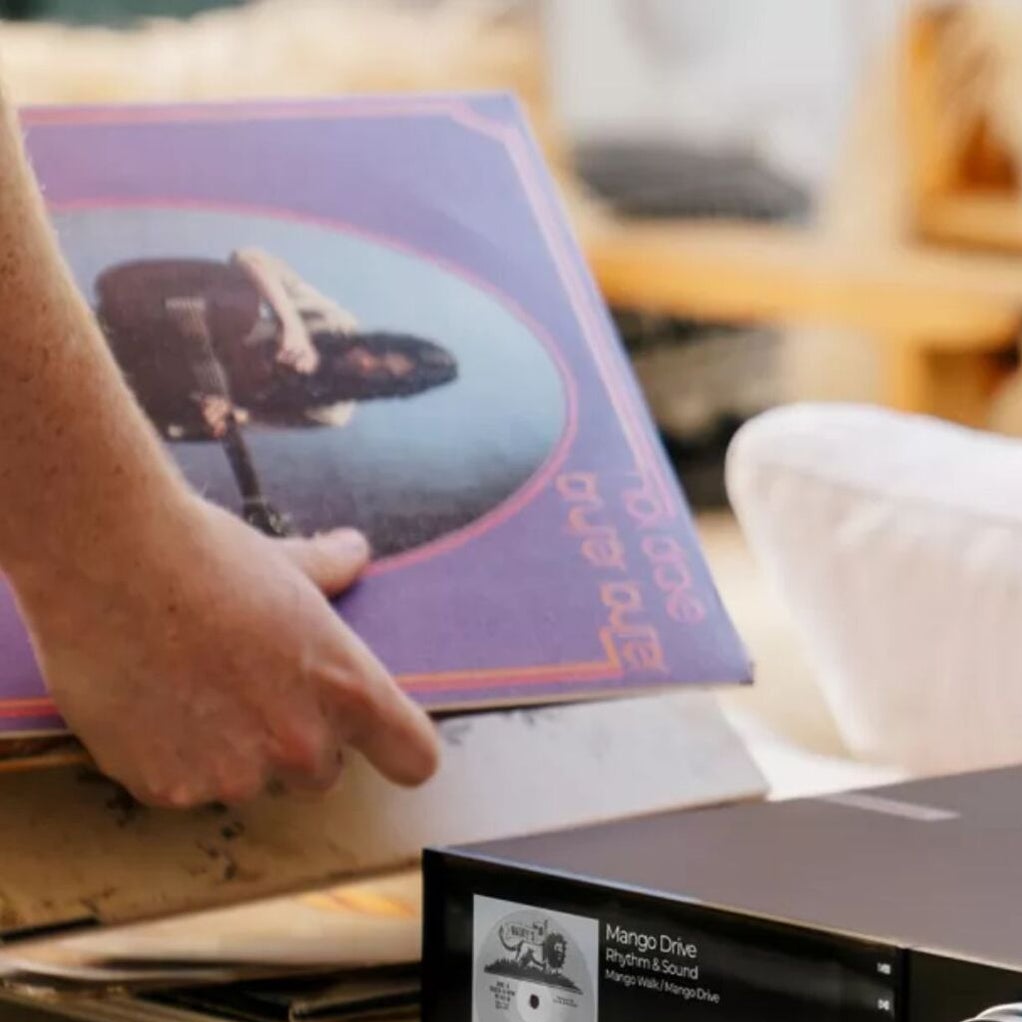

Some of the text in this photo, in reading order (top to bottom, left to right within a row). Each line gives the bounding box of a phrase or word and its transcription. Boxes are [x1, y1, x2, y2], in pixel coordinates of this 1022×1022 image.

[606, 923, 698, 958] Mango Drive
[606, 947, 698, 979] Rhythm & Sound
[605, 969, 636, 986] Mango
[665, 981, 696, 999] Mango
[697, 988, 720, 1003] Drive
